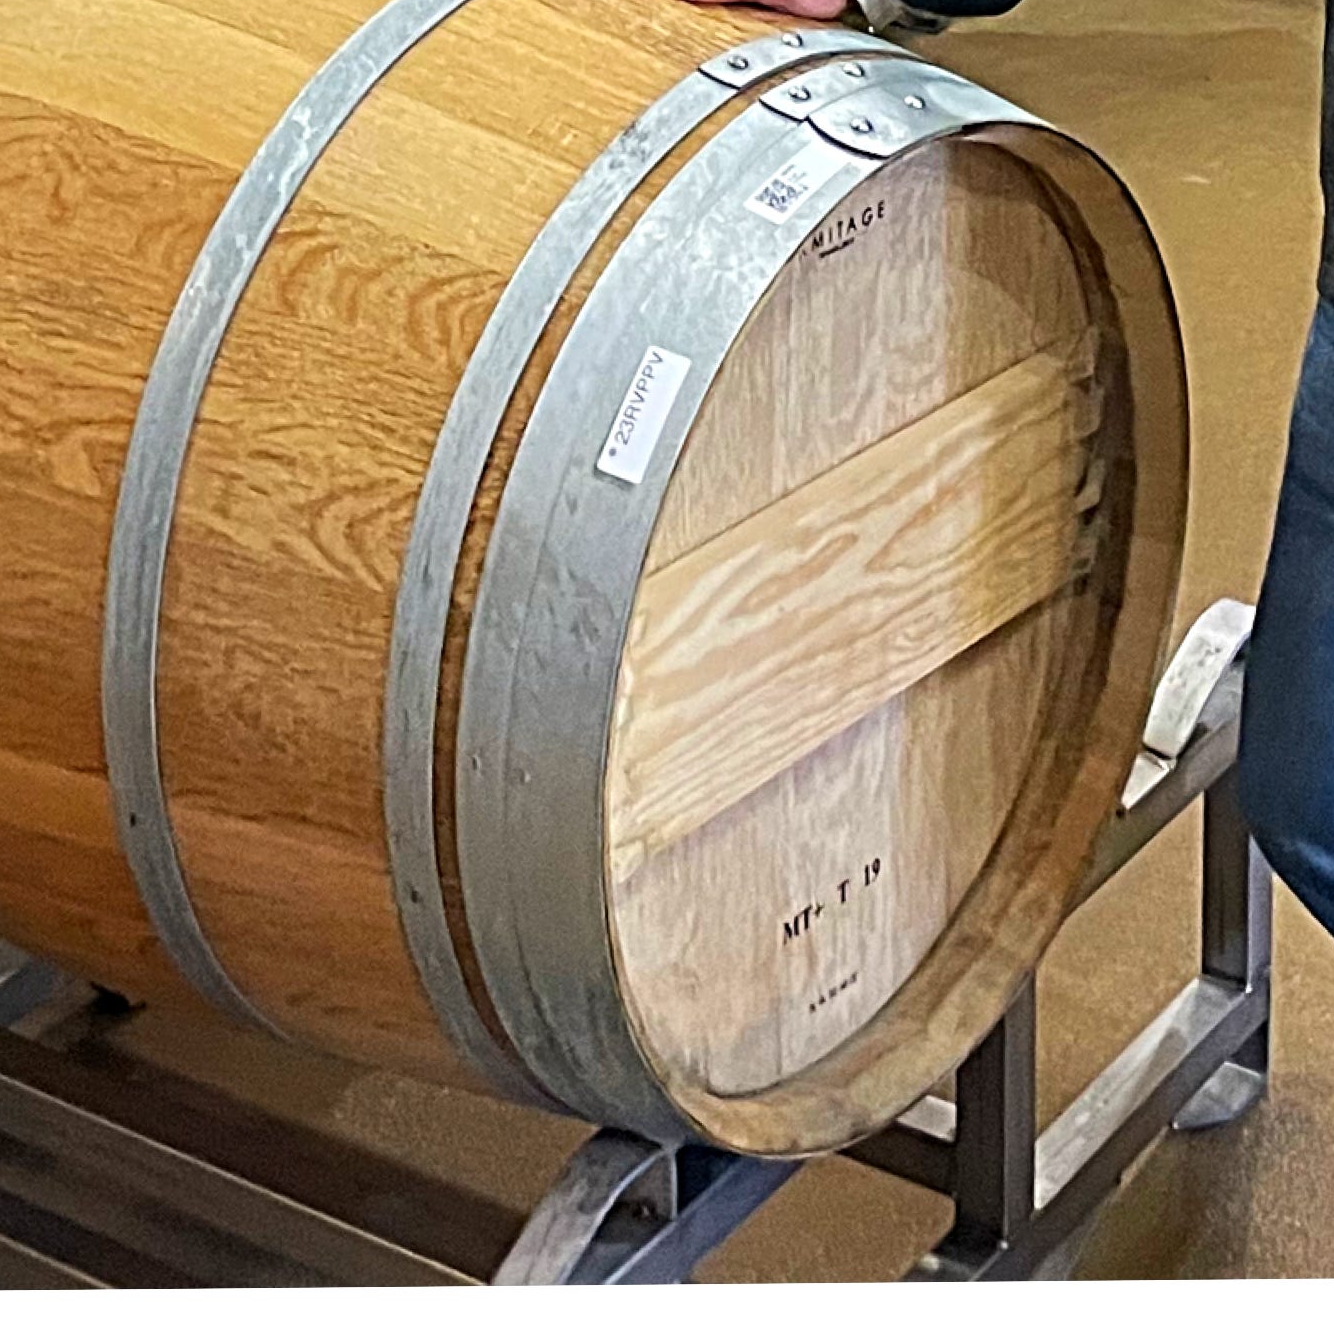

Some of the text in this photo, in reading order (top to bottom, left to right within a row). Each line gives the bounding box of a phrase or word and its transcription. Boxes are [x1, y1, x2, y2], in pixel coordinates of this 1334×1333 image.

[801, 199, 885, 258] MITAGE
[837, 878, 850, 904] T
[864, 857, 881, 887] 19
